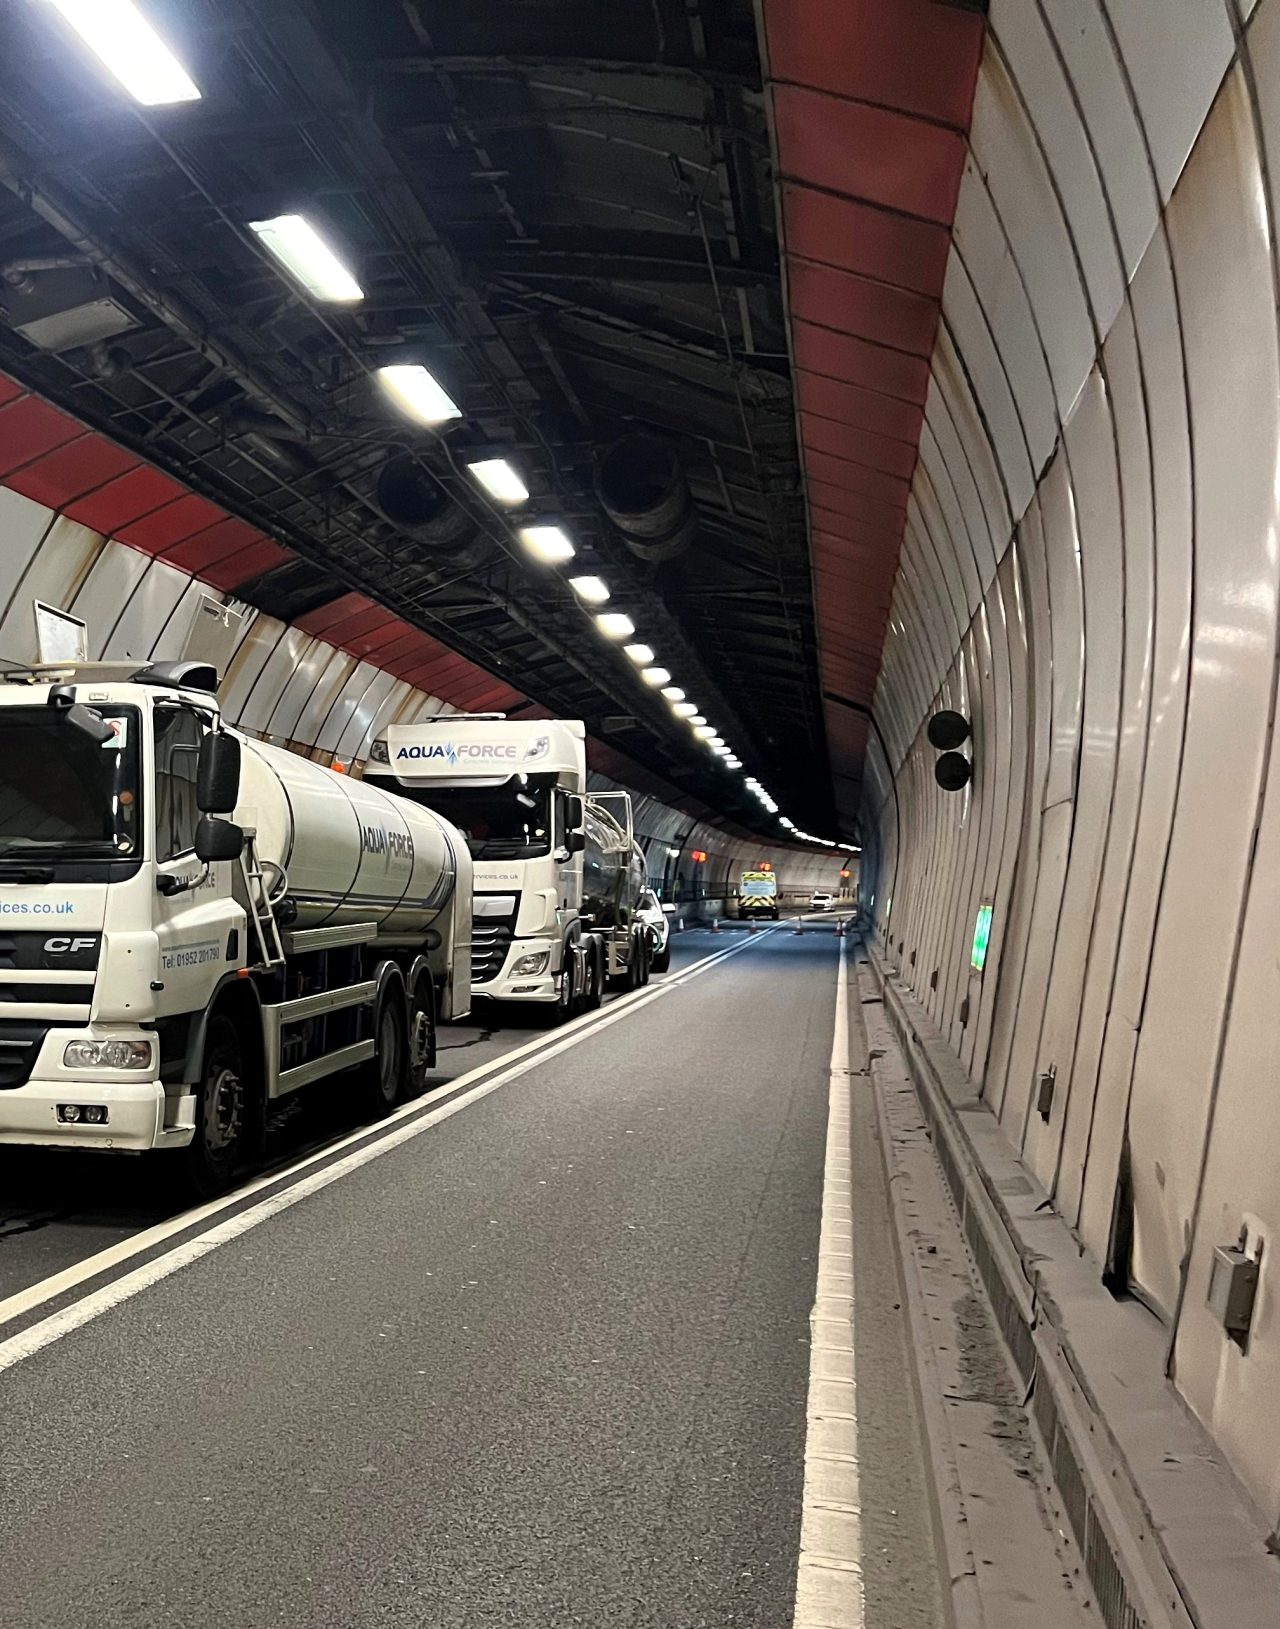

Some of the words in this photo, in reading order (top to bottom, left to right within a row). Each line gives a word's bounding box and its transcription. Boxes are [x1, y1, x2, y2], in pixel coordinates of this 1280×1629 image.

[396, 745, 445, 760] AQUA
[457, 744, 517, 758] FORCE
[362, 826, 386, 855] AQUA
[388, 831, 413, 860] FORCE
[43, 937, 96, 952] CF
[162, 955, 176, 969] Tel:
[176, 951, 198, 967] 01952
